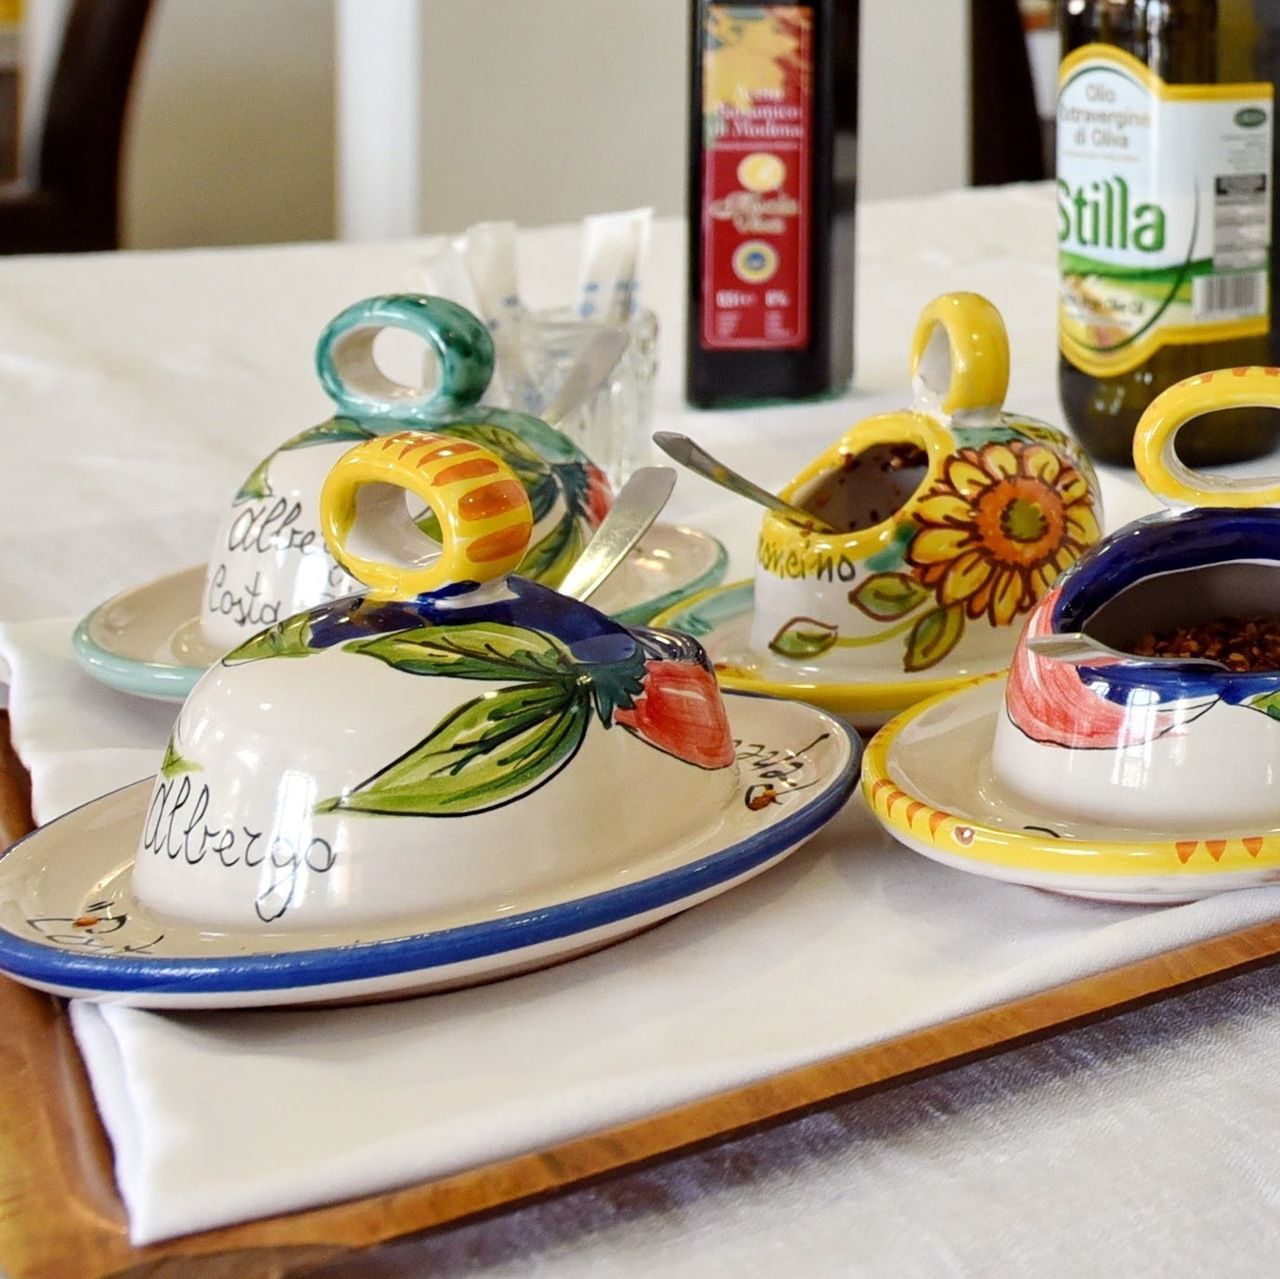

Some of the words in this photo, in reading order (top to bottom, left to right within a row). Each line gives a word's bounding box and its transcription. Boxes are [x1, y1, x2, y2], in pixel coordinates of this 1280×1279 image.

[1058, 176, 1165, 253] Stilla
[208, 564, 282, 627] Costa
[143, 775, 337, 923] Albergo
